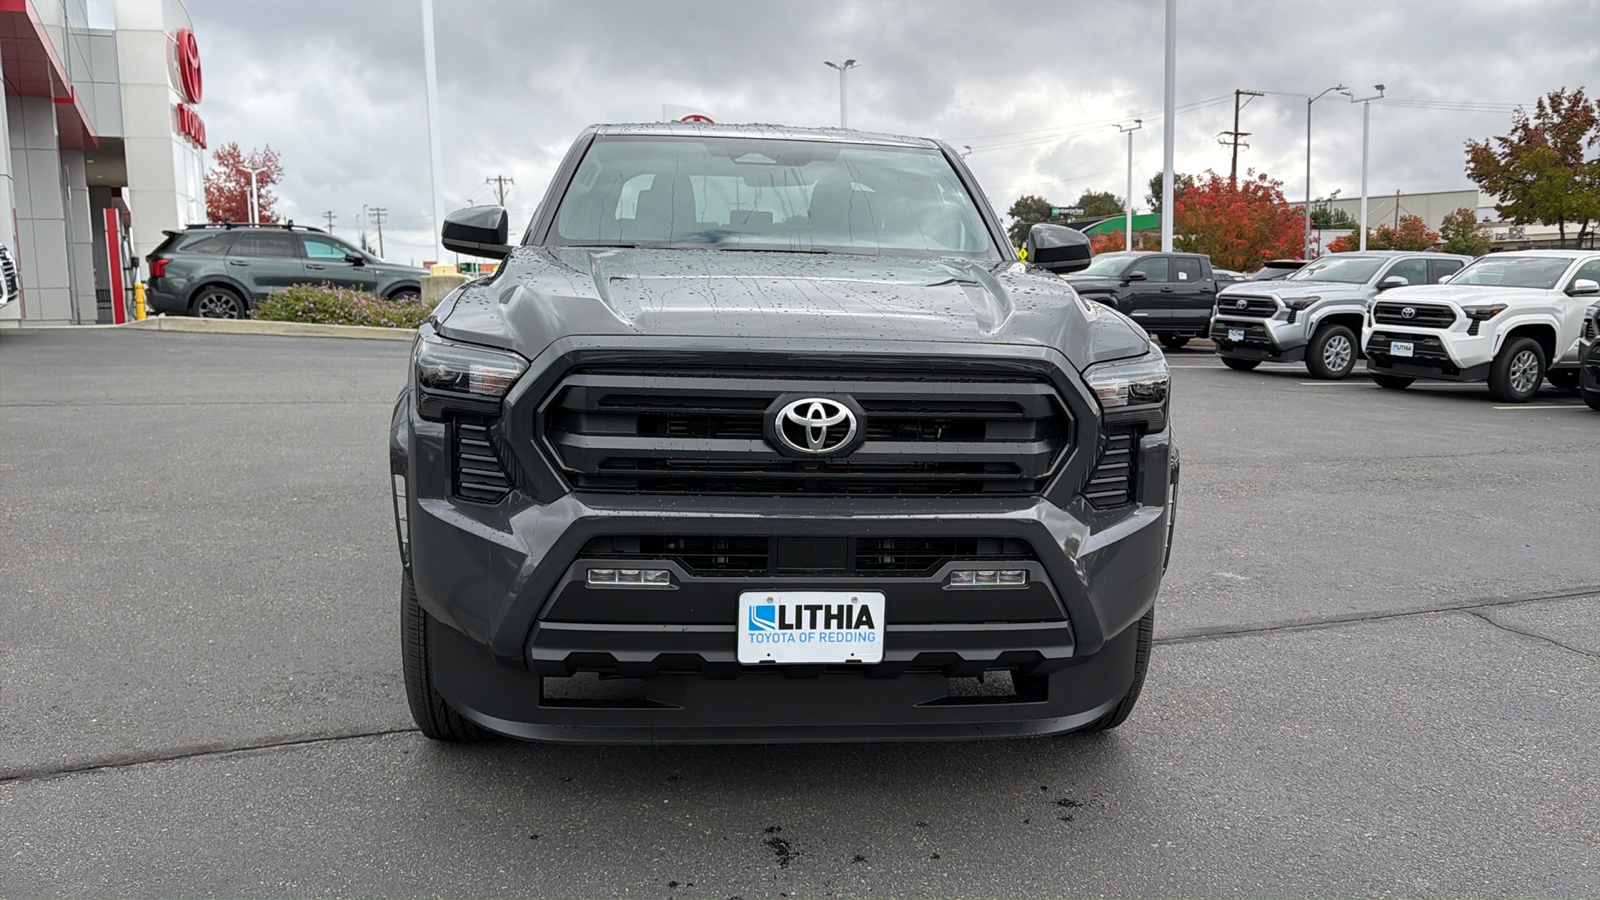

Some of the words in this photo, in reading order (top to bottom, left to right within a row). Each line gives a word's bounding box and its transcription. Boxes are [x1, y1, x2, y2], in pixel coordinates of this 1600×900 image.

[778, 604, 875, 630] LITHIA
[748, 632, 795, 643] TOYOTA
[799, 632, 815, 643] OF
[819, 632, 876, 643] REDDING
